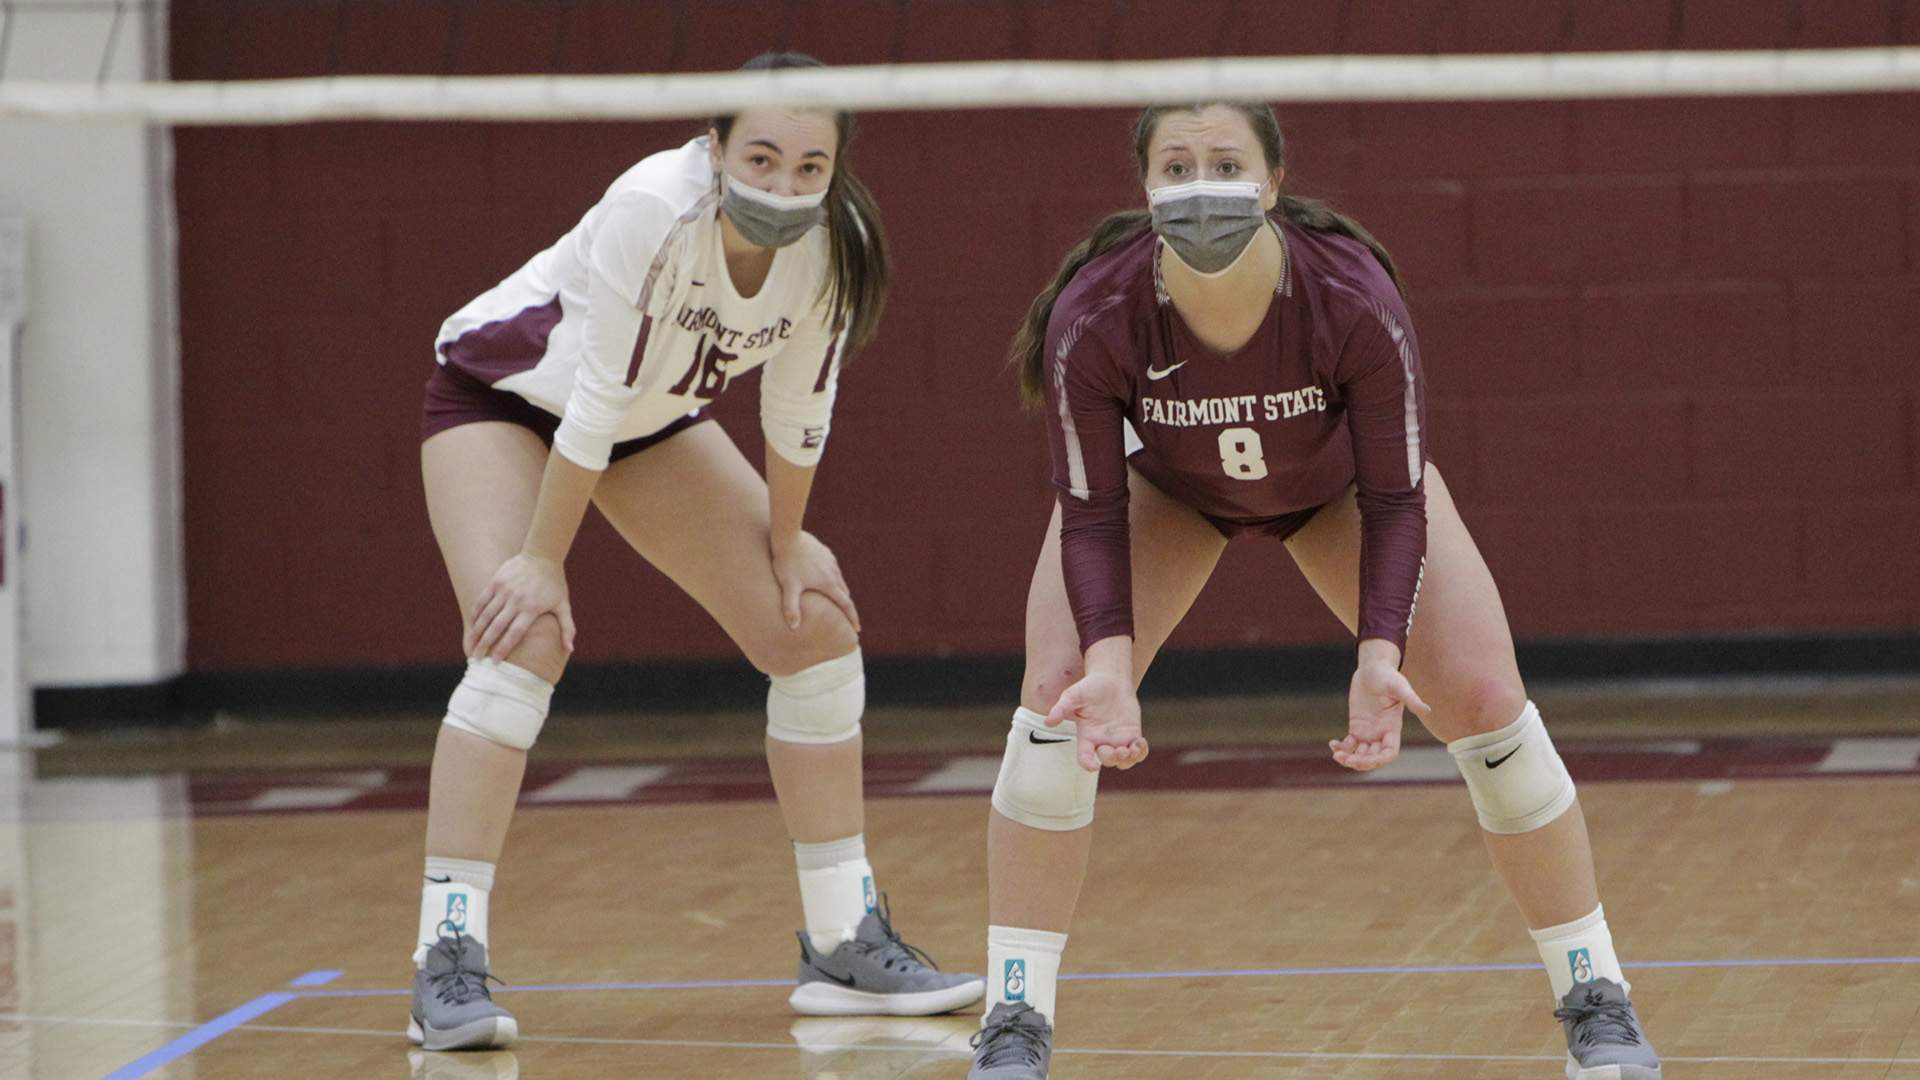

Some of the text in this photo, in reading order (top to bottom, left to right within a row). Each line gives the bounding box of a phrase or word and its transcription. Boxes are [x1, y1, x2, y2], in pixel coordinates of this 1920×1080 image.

[667, 333, 739, 399] 16
[1142, 385, 1327, 427] FAIRMONT STATE
[1217, 427, 1269, 481] 8
